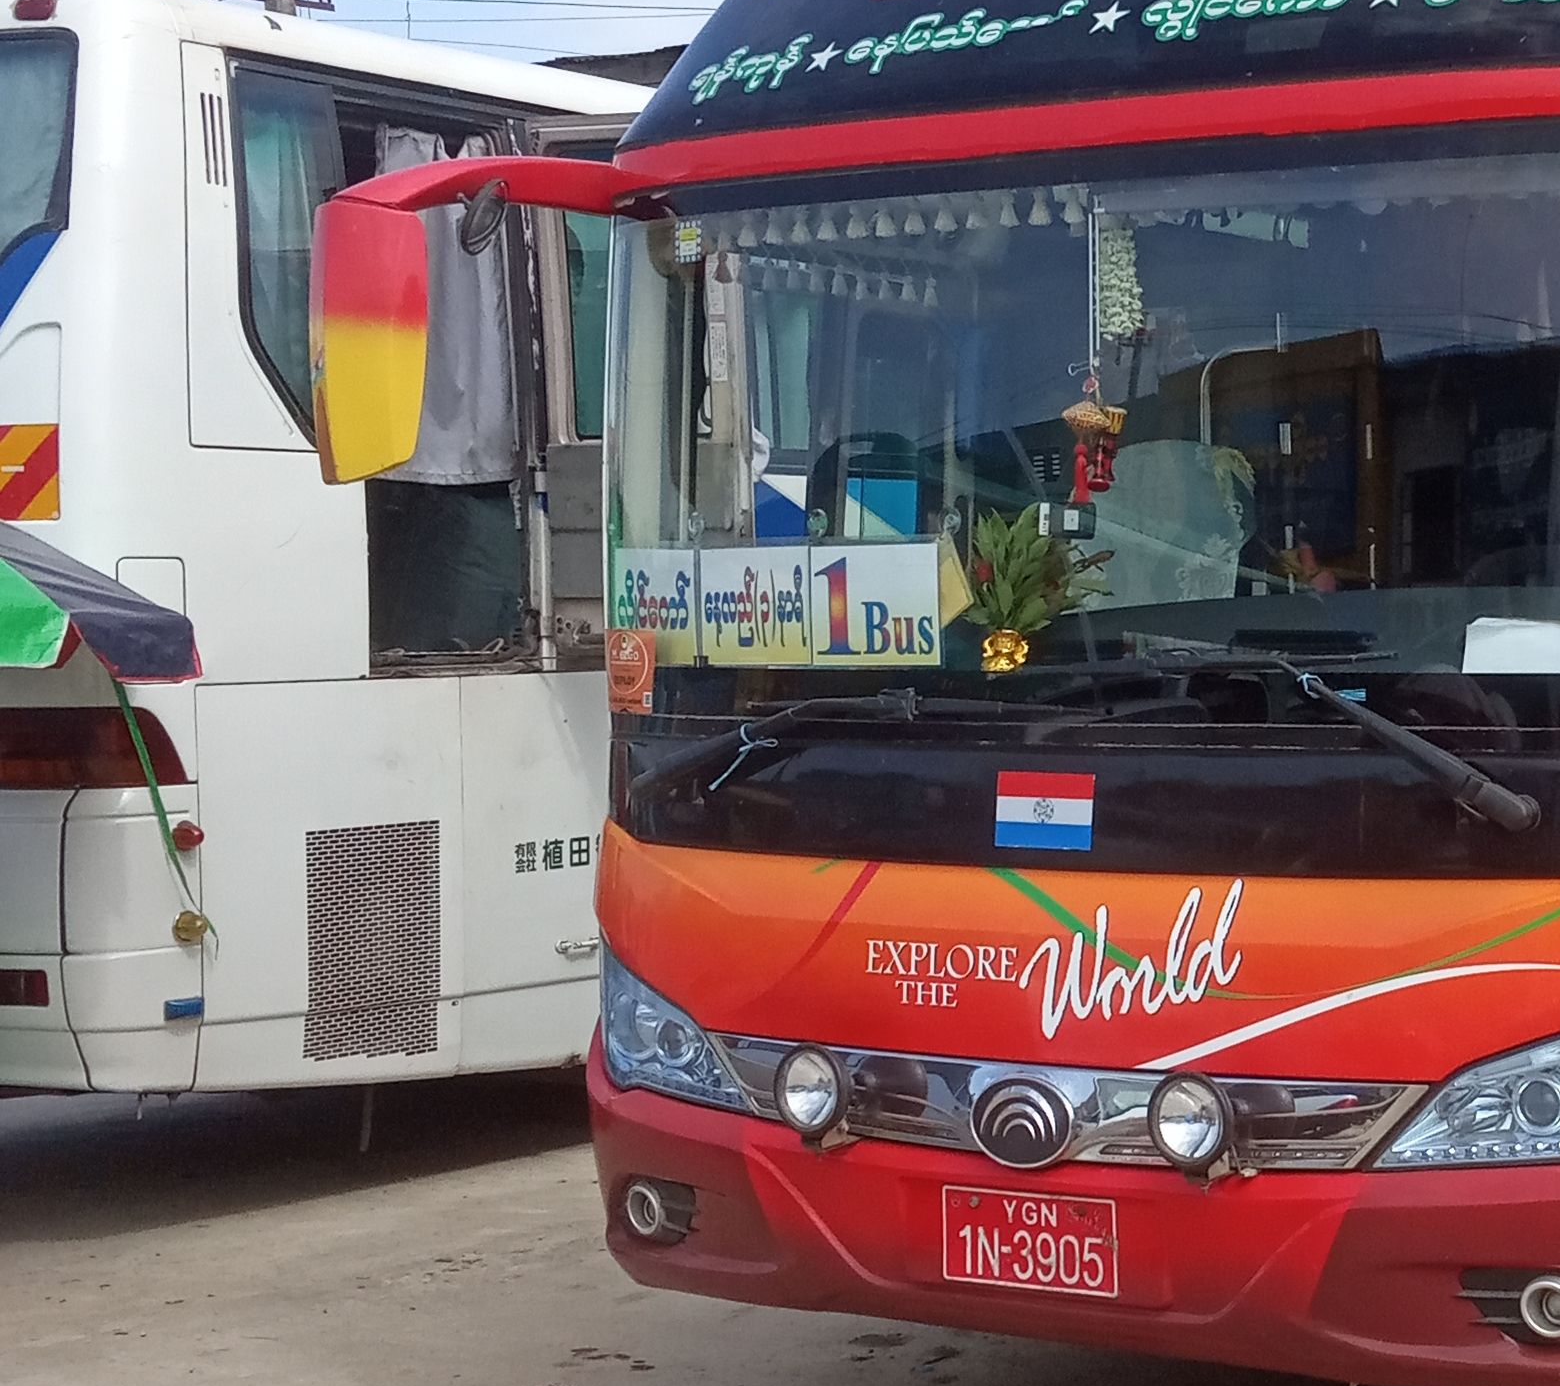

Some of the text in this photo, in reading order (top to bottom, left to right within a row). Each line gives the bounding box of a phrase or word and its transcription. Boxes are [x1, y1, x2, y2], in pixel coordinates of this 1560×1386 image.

[814, 556, 935, 656] 1 Bus
[865, 938, 1018, 982] EXPLORE
[895, 878, 1245, 1041] THE World
[1002, 1199, 1058, 1227] YGN
[958, 1224, 1105, 1287] 1N-3905
